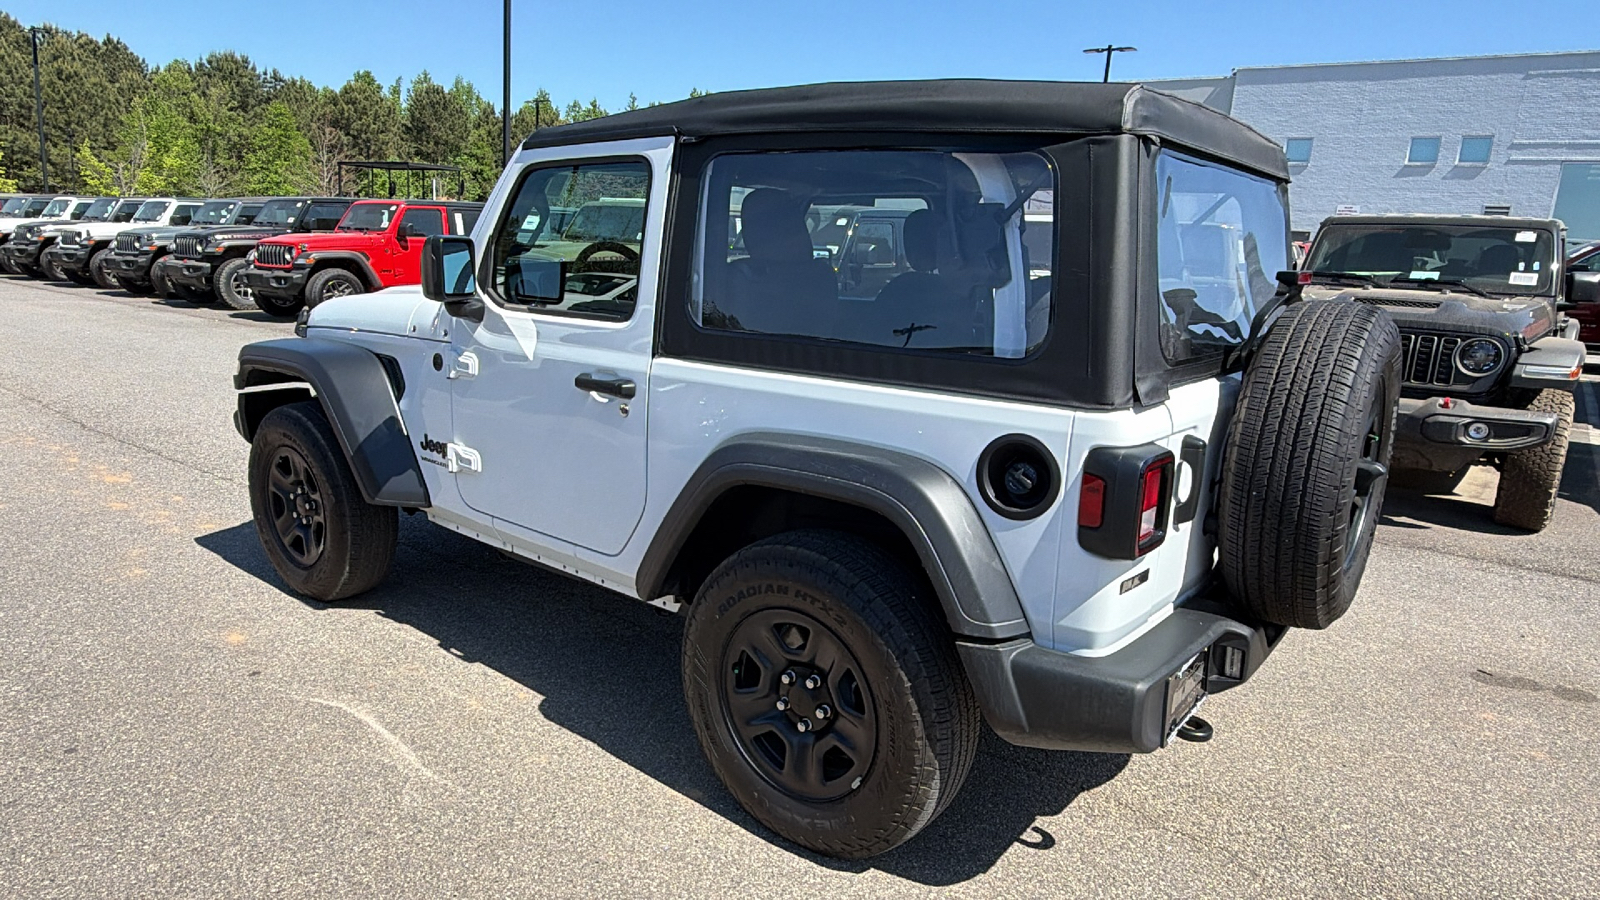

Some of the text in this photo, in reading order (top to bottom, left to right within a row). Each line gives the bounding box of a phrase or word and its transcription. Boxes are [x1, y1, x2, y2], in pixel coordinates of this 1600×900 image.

[420, 433, 448, 459] Jeep
[717, 583, 847, 628] ROADIAN HTX2
